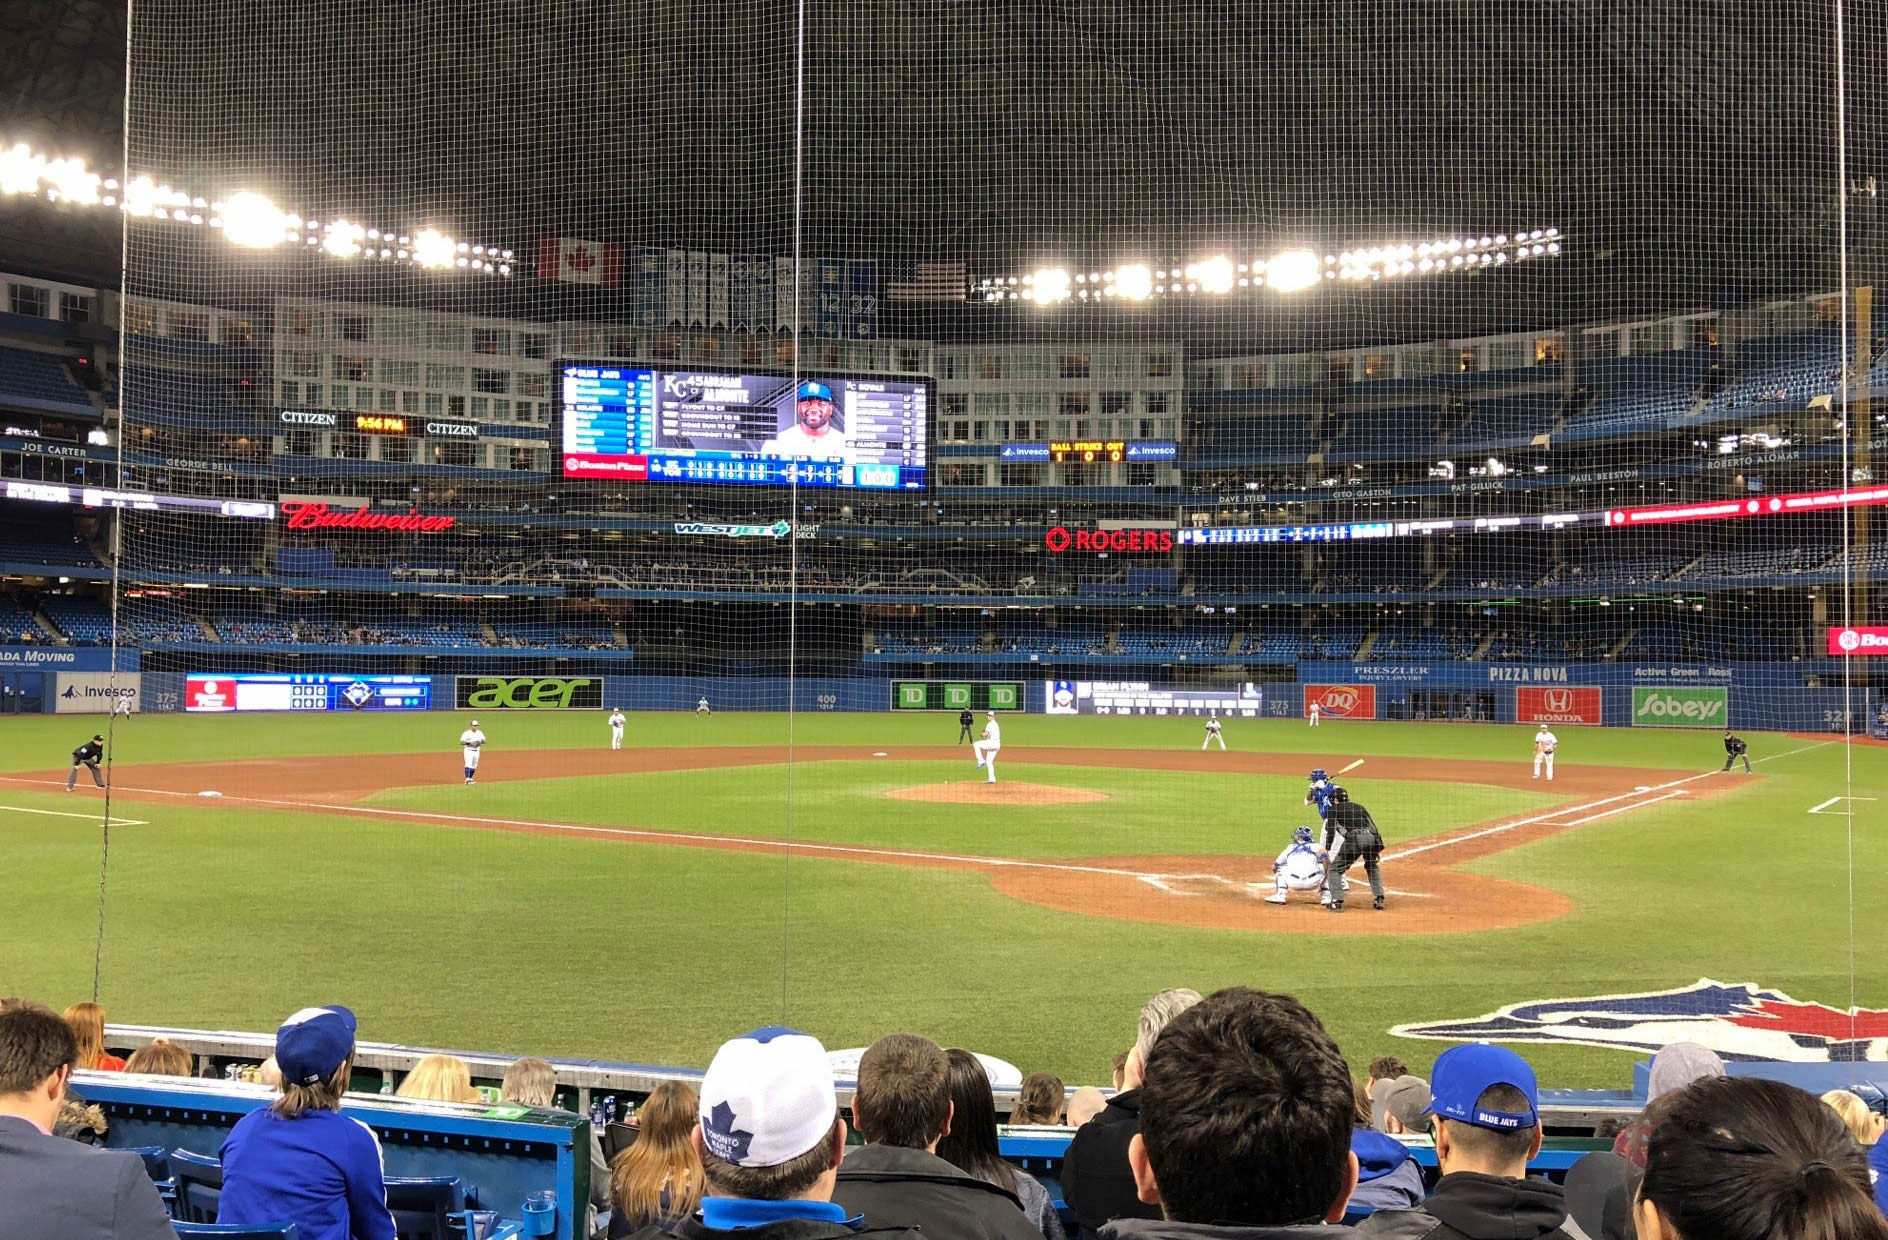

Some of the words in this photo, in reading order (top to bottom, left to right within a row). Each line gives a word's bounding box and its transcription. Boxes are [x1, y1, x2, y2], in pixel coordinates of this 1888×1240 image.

[850, 295, 876, 314] 32
[687, 375, 703, 387] 45
[281, 411, 336, 425] CITIZEN
[356, 416, 382, 430] 9:56
[384, 418, 404, 431] PM
[427, 422, 478, 436] CITIZEN
[21, 442, 43, 452] JOE
[47, 445, 87, 457] CARTER
[1051, 443, 1071, 451] BALL
[1074, 442, 1103, 451] STRIKE
[1106, 442, 1124, 451] OUT
[1056, 452, 1063, 462] 1
[1084, 451, 1094, 462] 0
[1111, 451, 1120, 462] 0
[1707, 456, 1753, 470] ROBERTO
[1757, 451, 1800, 464] ALOMAR
[166, 459, 208, 469] GEORGE
[212, 463, 233, 472] BELL
[1570, 473, 1593, 483] PAUL
[1356, 488, 1392, 497] GASTON
[1450, 483, 1467, 492] PAT
[1470, 481, 1504, 491] GILLICK
[1219, 495, 1240, 504] DAVE
[1243, 494, 1267, 503] STIEB
[281, 502, 456, 531] Budweiser
[796, 531, 816, 539] DECK
[1076, 529, 1173, 552] ROGERS
[1354, 666, 1429, 674] PRESZLER
[1490, 667, 1529, 681] PIZZA
[1533, 667, 1568, 681] NOVA
[1634, 667, 1666, 676] Active
[1670, 667, 1699, 676] Green
[85, 685, 136, 697] Invesco
[468, 678, 591, 708] acer
[902, 688, 923, 703] TD
[947, 688, 969, 704] TD
[992, 688, 1013, 704] TD
[156, 692, 178, 704] 375
[817, 694, 836, 704] 400
[1327, 693, 1353, 711] DQ
[1269, 700, 1289, 710] 375
[1637, 693, 1722, 720] Sobeys
[1533, 714, 1584, 722] HONDA
[1479, 1112, 1498, 1125] BLUE
[1499, 1118, 1518, 1127] JAYS
[706, 1127, 739, 1147] TORONTO
[711, 1139, 733, 1154] MAPLE
